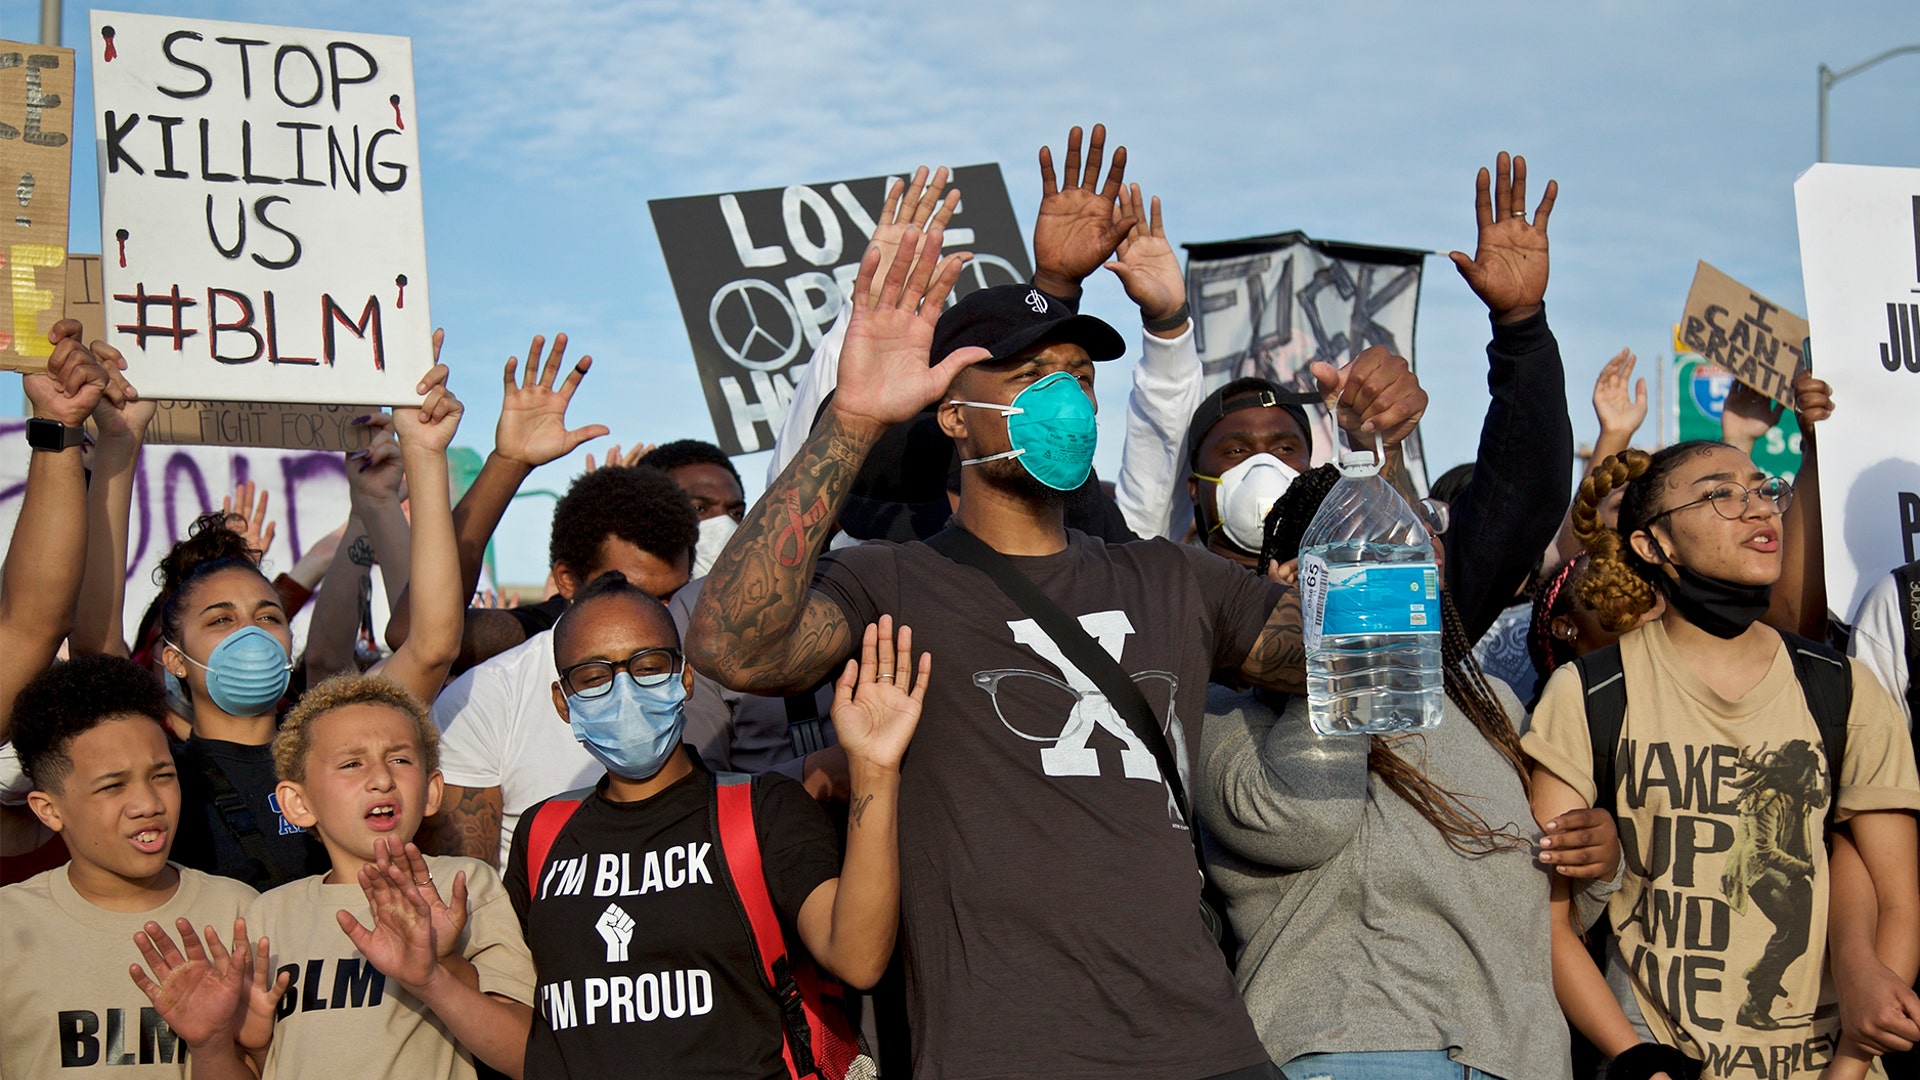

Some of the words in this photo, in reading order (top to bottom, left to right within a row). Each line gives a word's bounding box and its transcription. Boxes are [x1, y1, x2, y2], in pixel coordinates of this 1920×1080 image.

[157, 31, 379, 112] STOP
[105, 110, 408, 194] KILLING
[205, 194, 302, 270] US
[719, 166, 976, 268] LOVE
[113, 282, 386, 372] #BLM
[1189, 254, 1421, 364] FUCK
[1703, 304, 1804, 383] CAN'T
[1744, 293, 1778, 333] I
[198, 409, 267, 443] FIGHT
[280, 412, 326, 448] FOR
[1006, 610, 1162, 784] X
[541, 853, 588, 901] I'M
[593, 842, 714, 897] BLACK
[1618, 813, 1736, 888] UP
[1617, 886, 1730, 951] AND
[277, 958, 387, 1023] BLM
[585, 969, 714, 1025] PROUD
[58, 1006, 186, 1068] BLM
